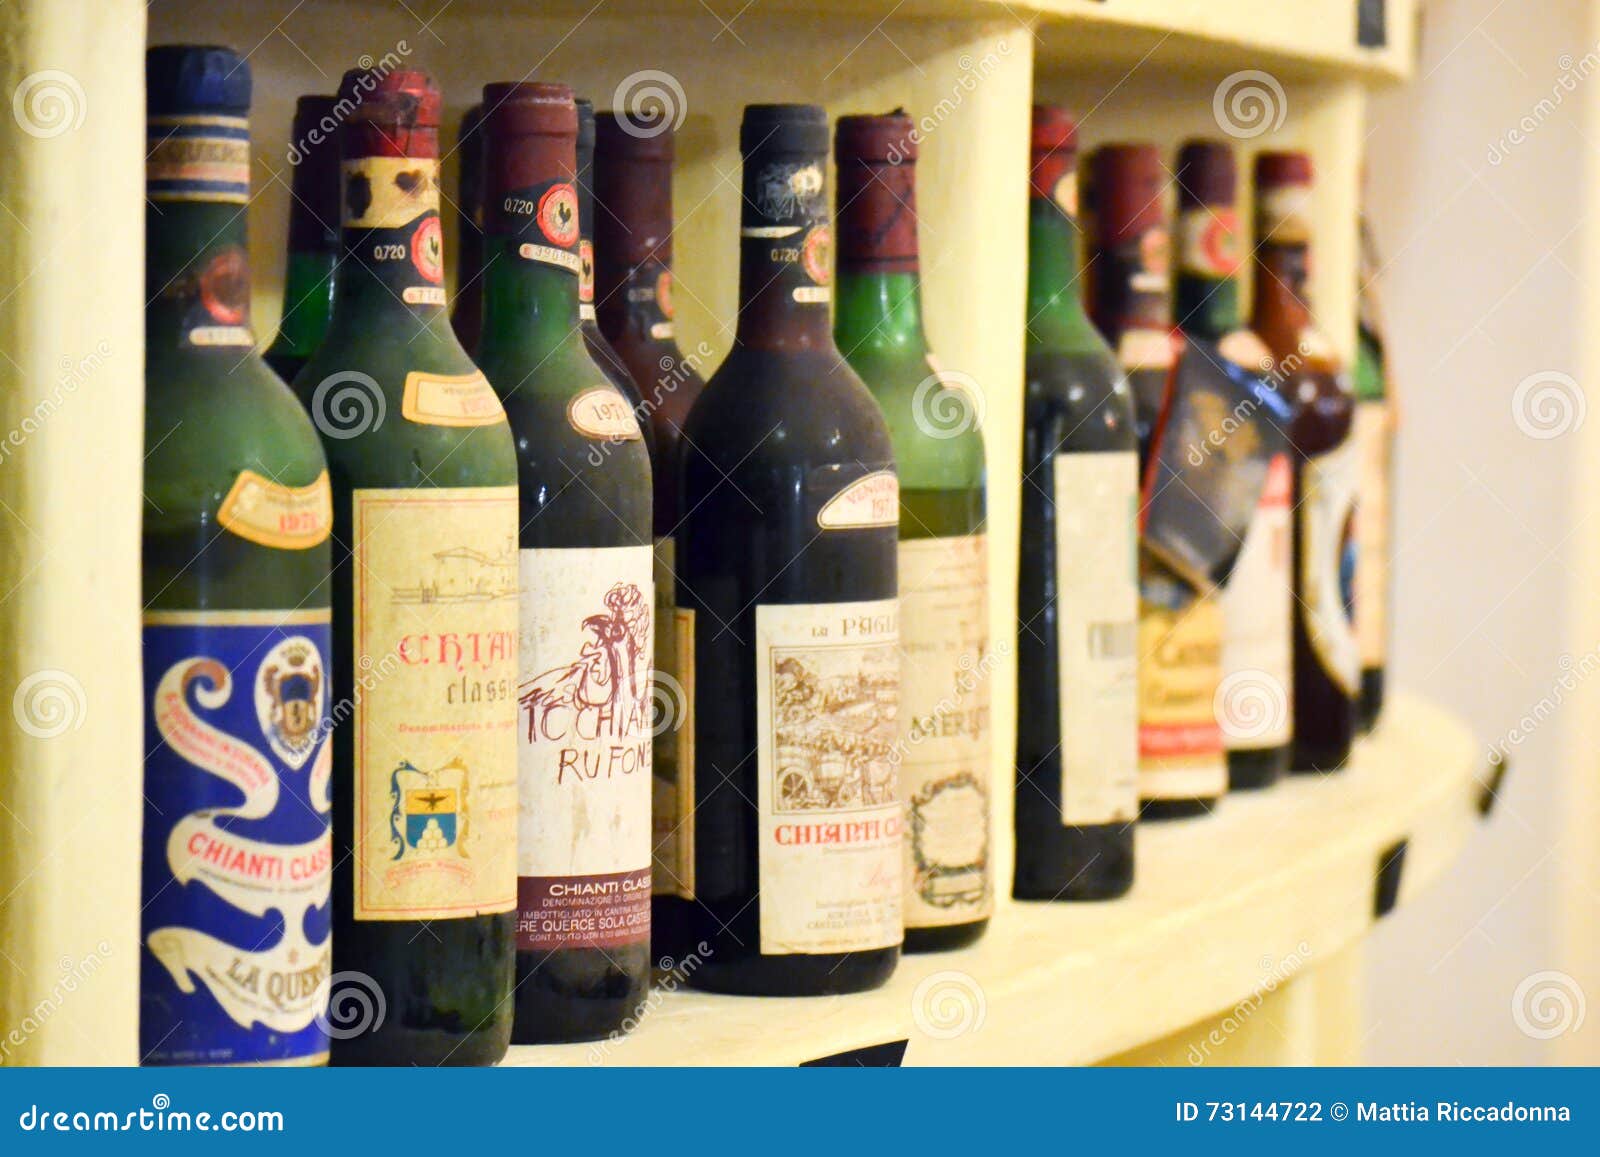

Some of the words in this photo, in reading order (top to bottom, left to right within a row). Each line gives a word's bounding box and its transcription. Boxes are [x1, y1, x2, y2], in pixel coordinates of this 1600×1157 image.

[188, 832, 284, 881] CHIANTI
[549, 881, 619, 896] CHIANTI
[542, 919, 595, 932] QUERCE
